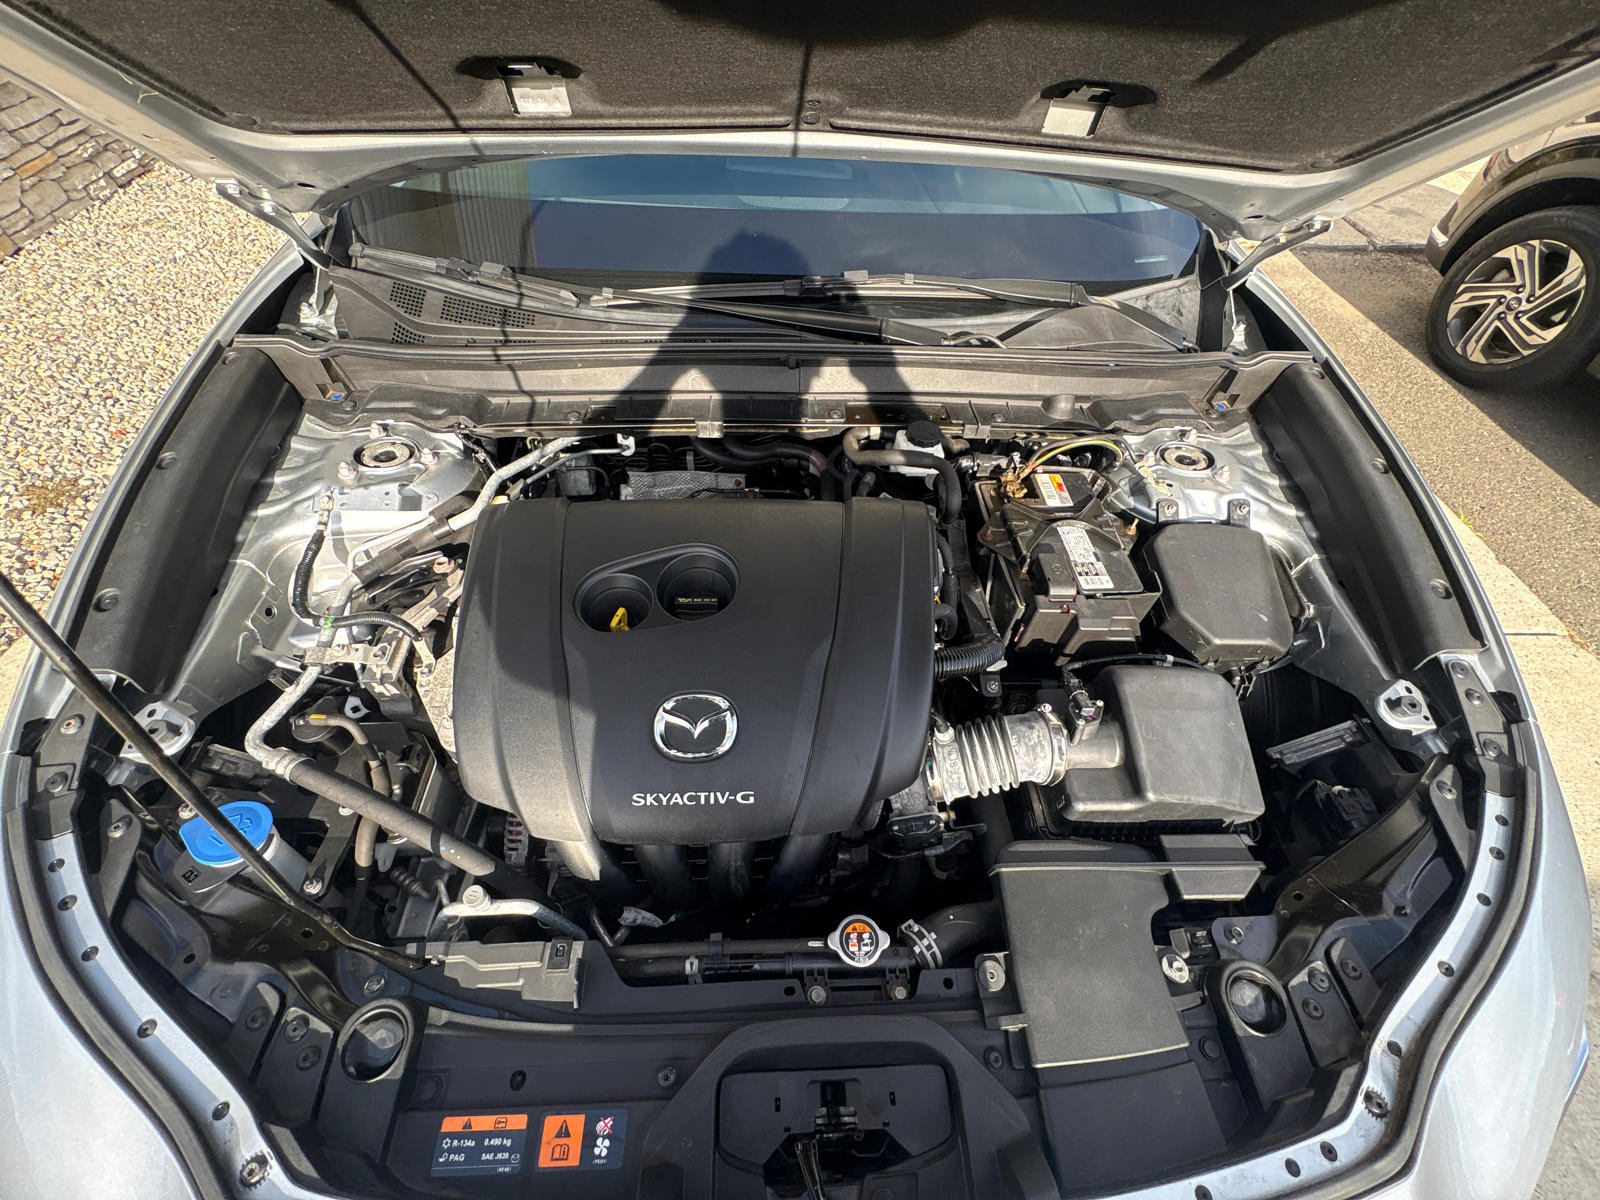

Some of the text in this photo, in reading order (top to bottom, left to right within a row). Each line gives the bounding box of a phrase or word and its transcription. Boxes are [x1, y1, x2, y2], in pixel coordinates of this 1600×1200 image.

[631, 791, 755, 806] SKYACTIV-G
[452, 1139, 476, 1147] R-134a
[483, 1137, 512, 1147] 0.490 kg
[448, 1153, 466, 1162] PAG
[481, 1151, 509, 1161] SAE J639
